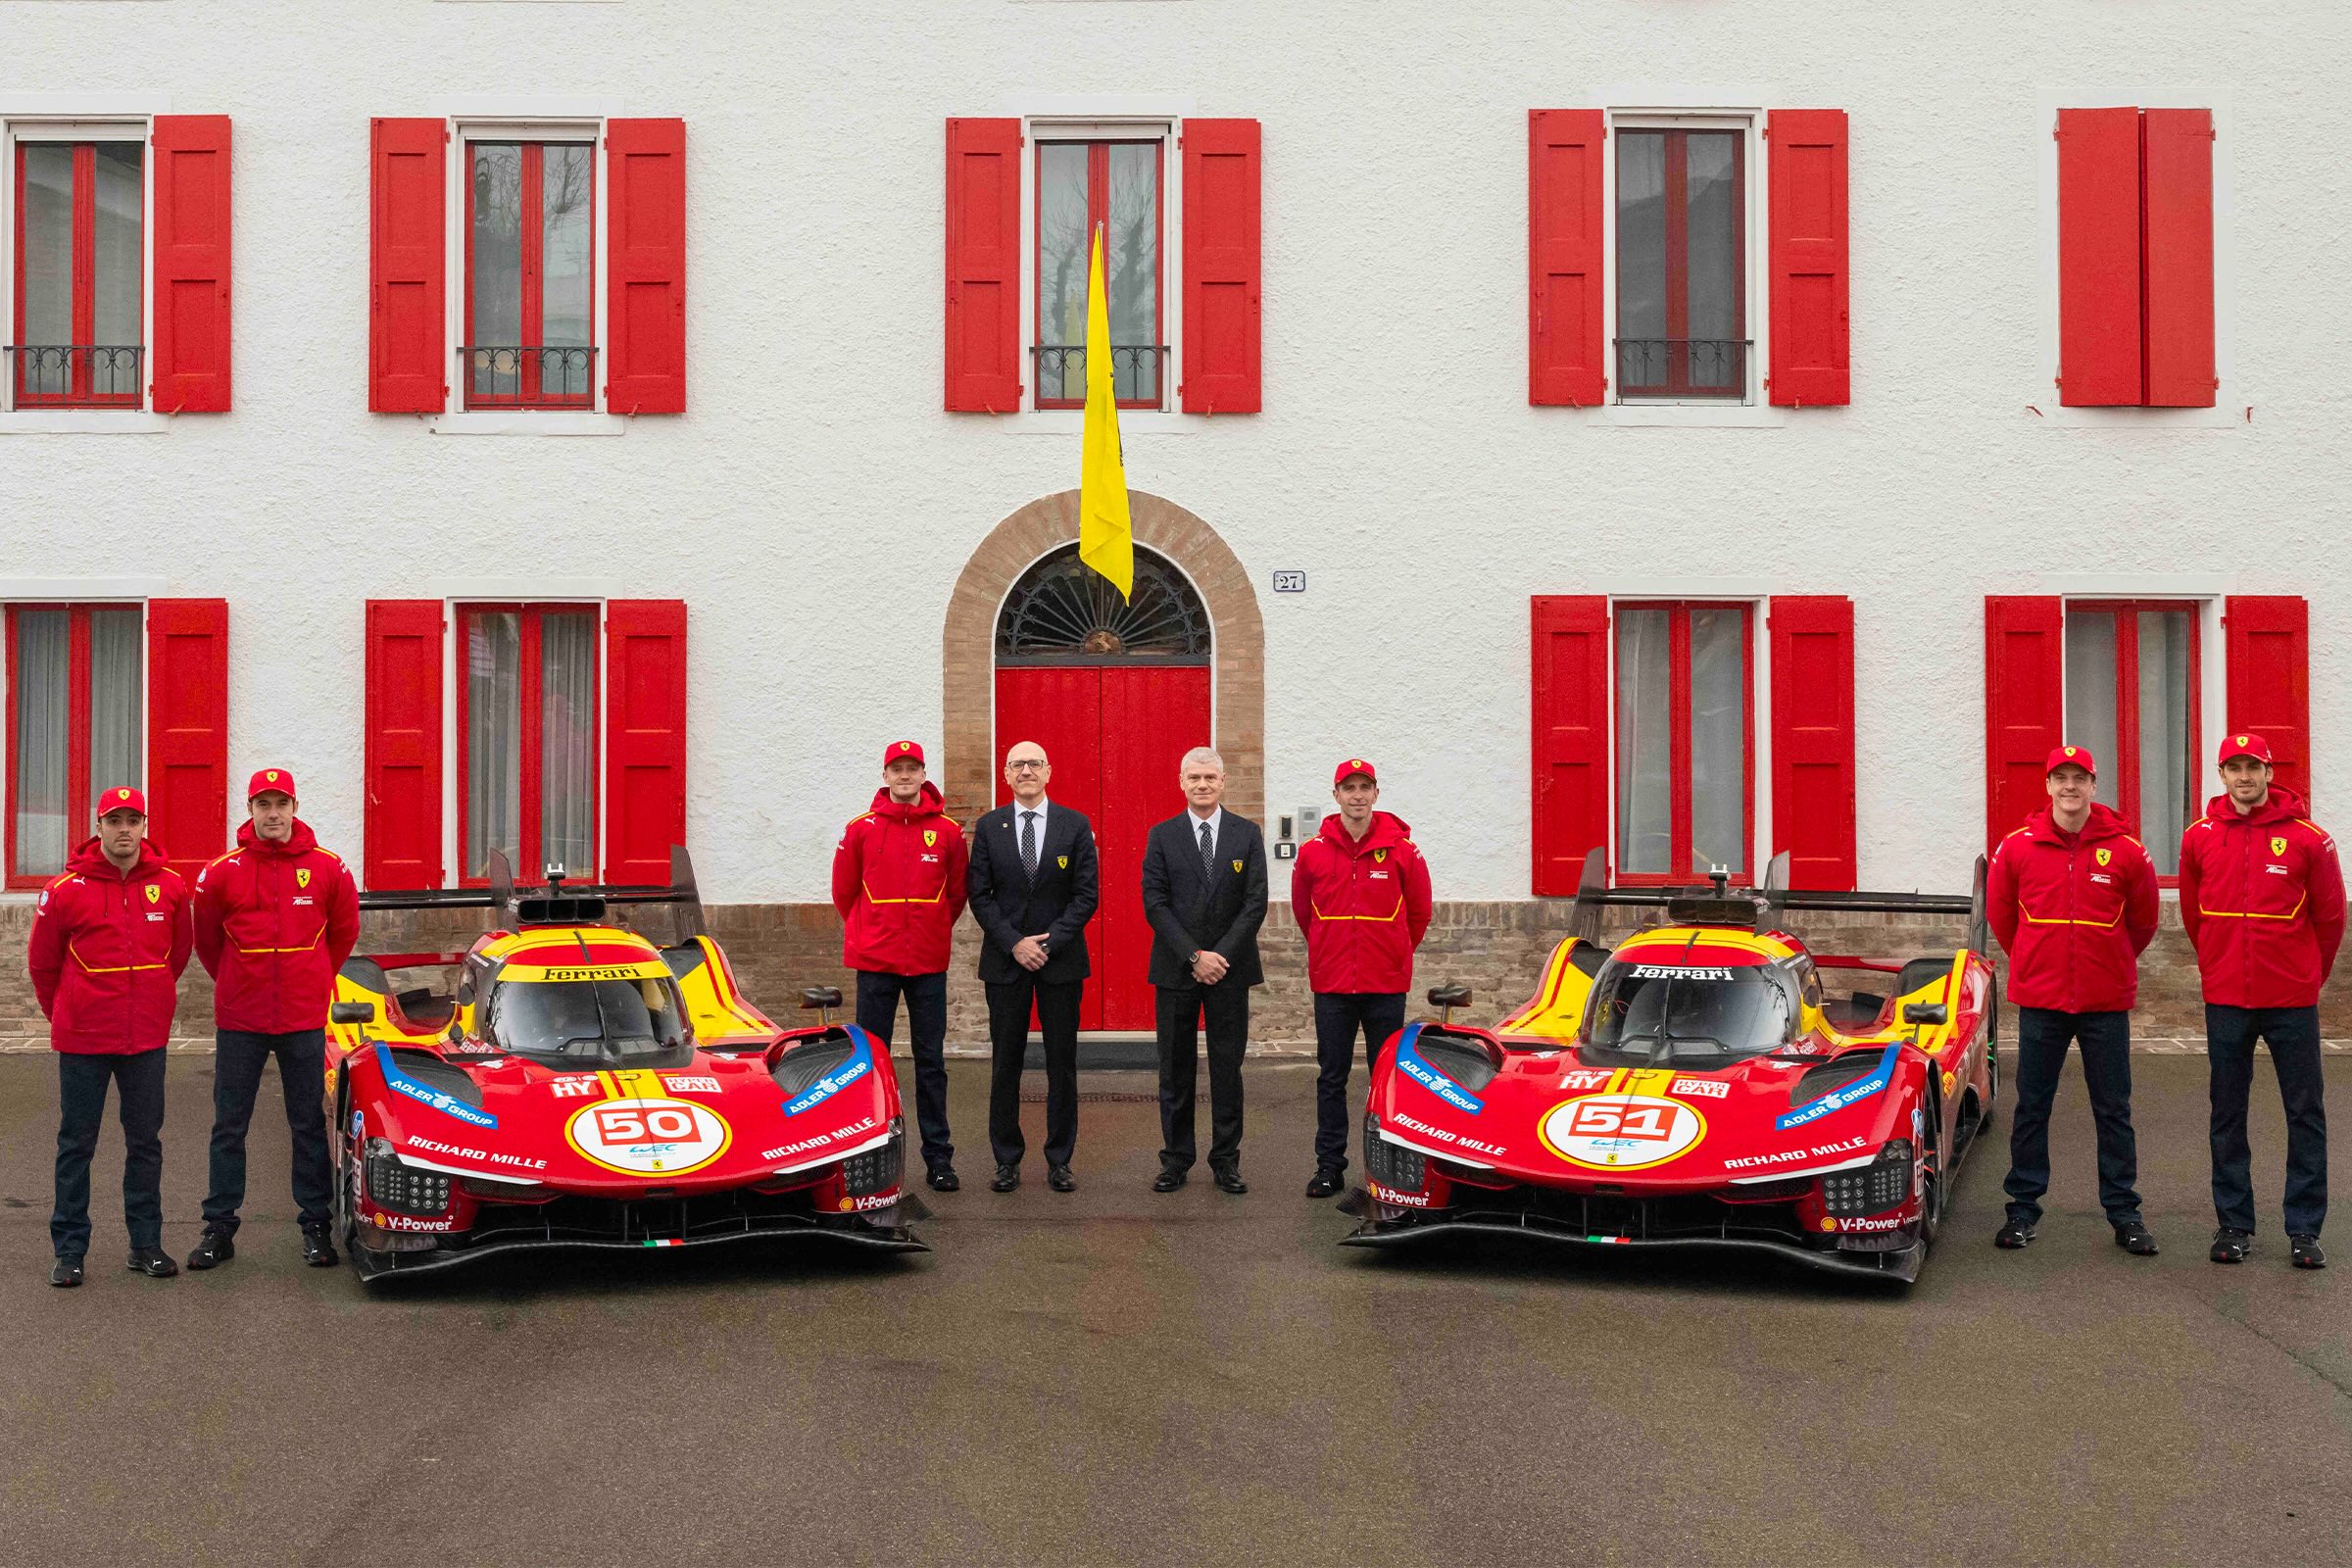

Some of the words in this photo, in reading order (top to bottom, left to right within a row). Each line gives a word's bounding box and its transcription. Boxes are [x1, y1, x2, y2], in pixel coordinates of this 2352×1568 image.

[1279, 575, 1298, 589] 27
[541, 965, 642, 981] Ferrari
[1629, 964, 1734, 981] Ferrari
[552, 1081, 591, 1098] HY
[671, 1082, 717, 1091] CAR
[789, 1090, 827, 1113] ADLER
[834, 1061, 867, 1086] GROUP
[1398, 1059, 1433, 1084] ADLER
[1441, 1088, 1479, 1111] GROUP
[1559, 1075, 1604, 1090] HY
[1677, 1085, 1723, 1097] CAR
[390, 1080, 434, 1102] ADLER
[448, 1104, 493, 1126] GROUP
[1784, 1105, 1829, 1127] ADLER
[1841, 1079, 1884, 1102] GROUP
[601, 1110, 693, 1141] 50
[1576, 1105, 1667, 1137] 51
[761, 1135, 832, 1160] RICHARD
[831, 1117, 876, 1141] MILLE
[1394, 1113, 1457, 1143] RICHARD
[1456, 1136, 1507, 1156] MILLE
[408, 1135, 488, 1160] RICHARD
[490, 1152, 548, 1169] MILLE
[1724, 1150, 1808, 1169] RICHARD
[1811, 1136, 1867, 1156] MILLE
[856, 1197, 899, 1210] V-Power
[1378, 1187, 1430, 1206] V-Power
[387, 1216, 453, 1231] V-Power
[1839, 1217, 1900, 1231] V-Power
